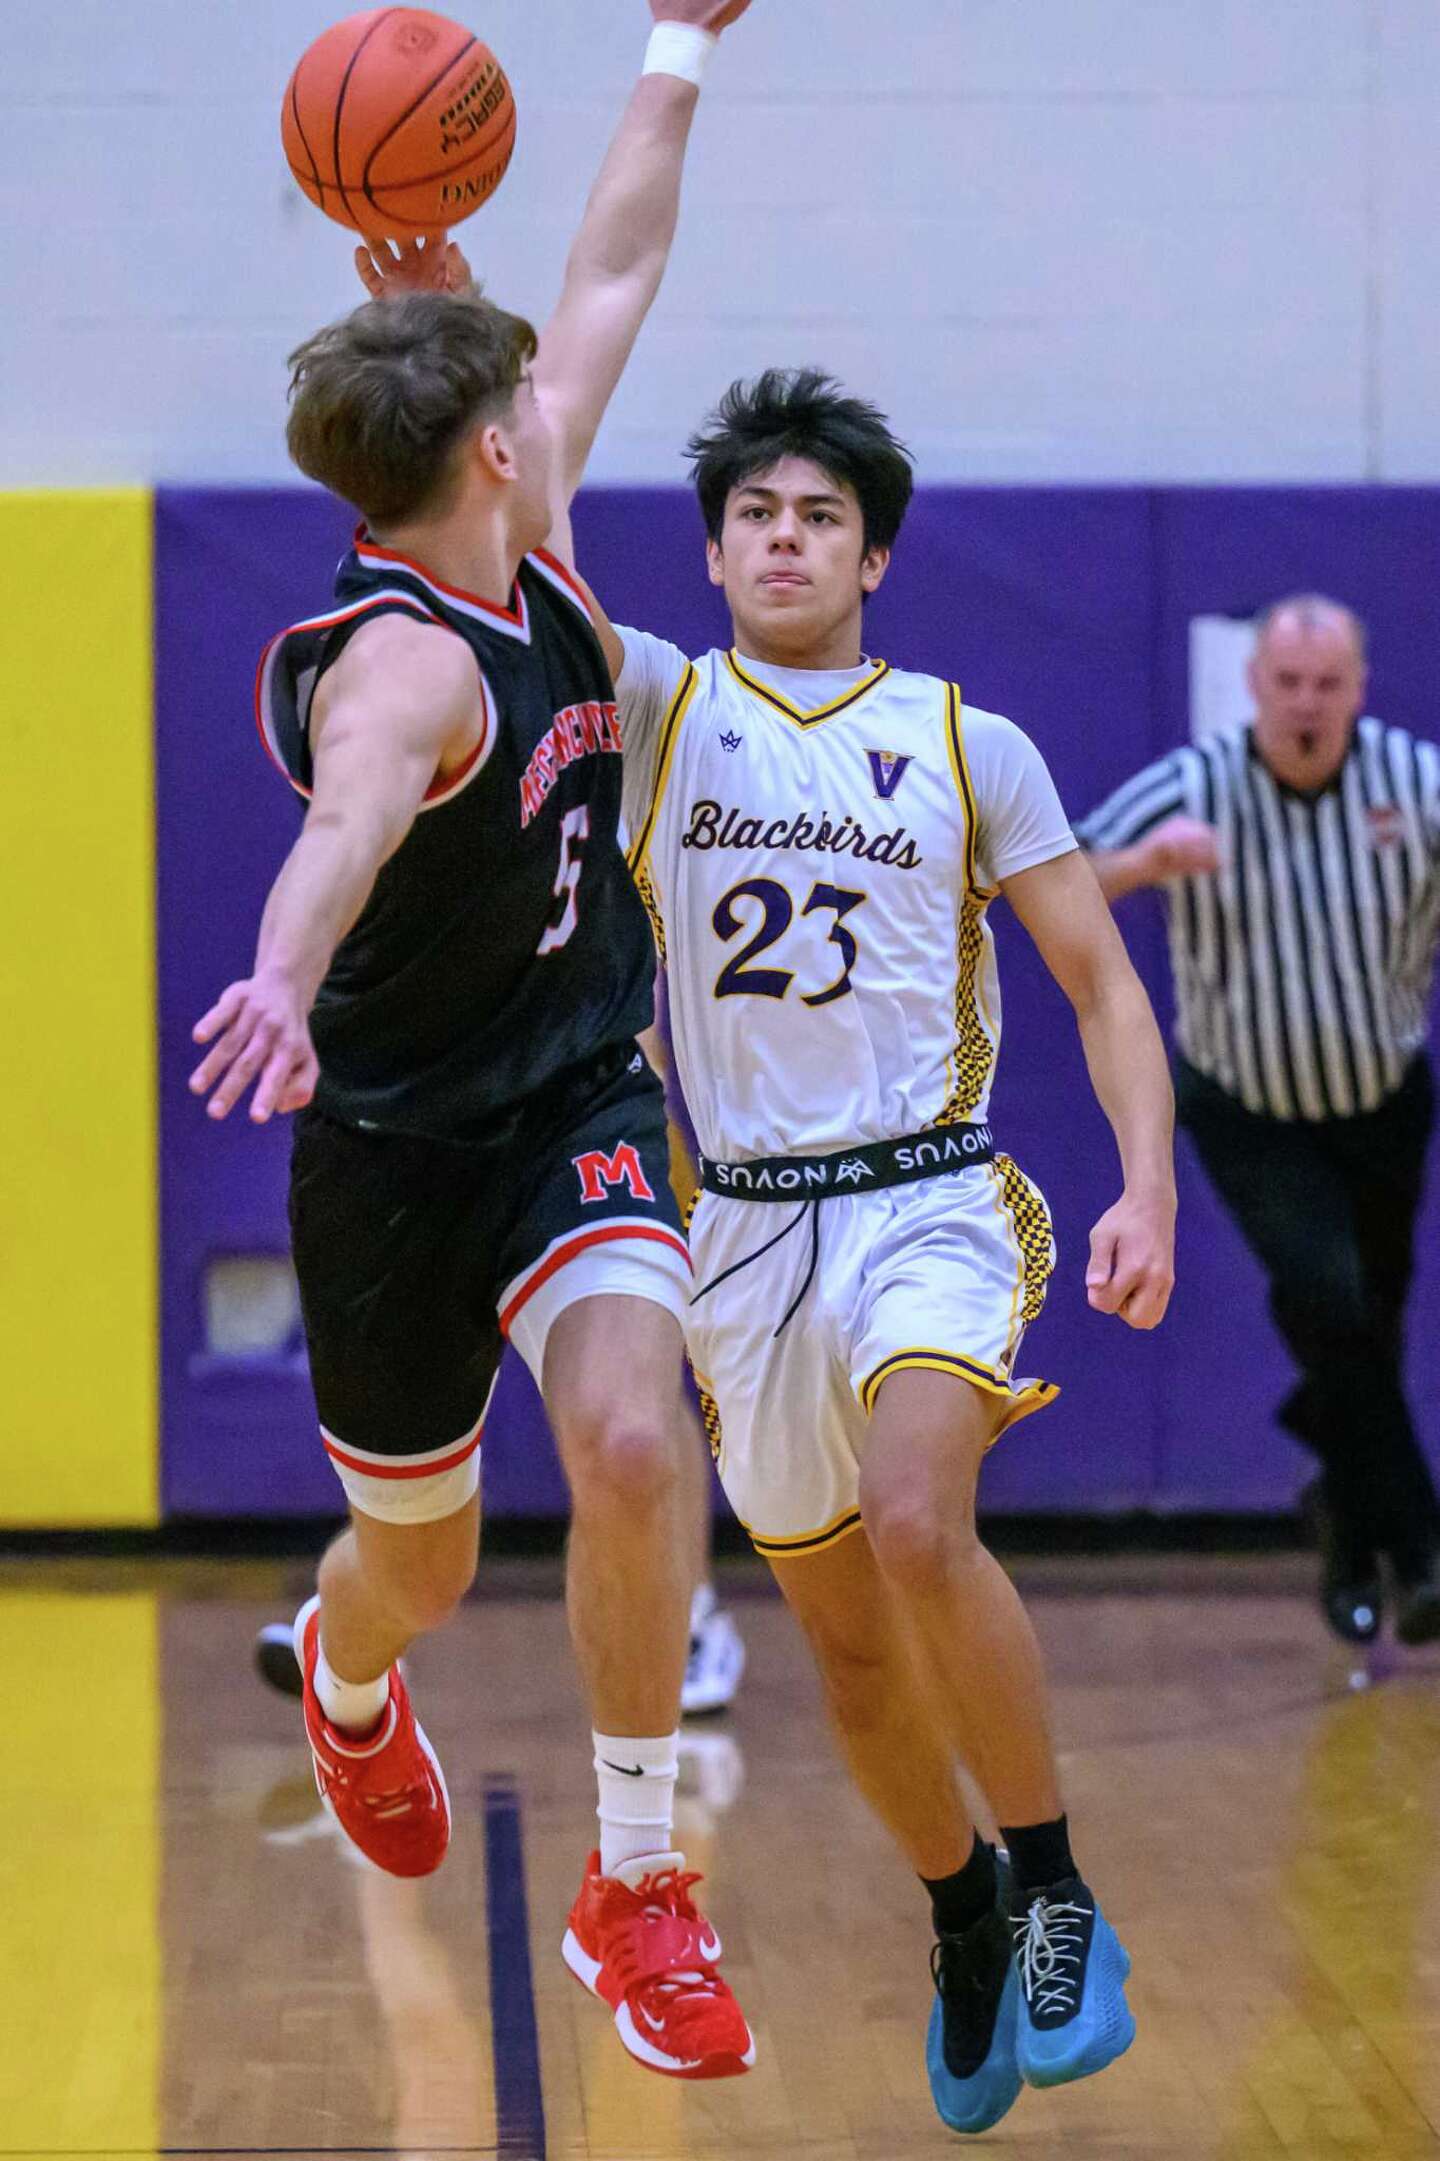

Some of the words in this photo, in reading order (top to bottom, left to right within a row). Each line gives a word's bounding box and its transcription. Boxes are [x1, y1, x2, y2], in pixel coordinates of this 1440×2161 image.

[863, 748, 916, 801] V
[682, 800, 923, 869] Blackbirds
[536, 804, 590, 956] 5
[712, 878, 867, 1006] 23
[571, 1140, 655, 1205] M
[715, 1163, 827, 1190] NOVUS
[894, 1126, 993, 1170] NOVUS
